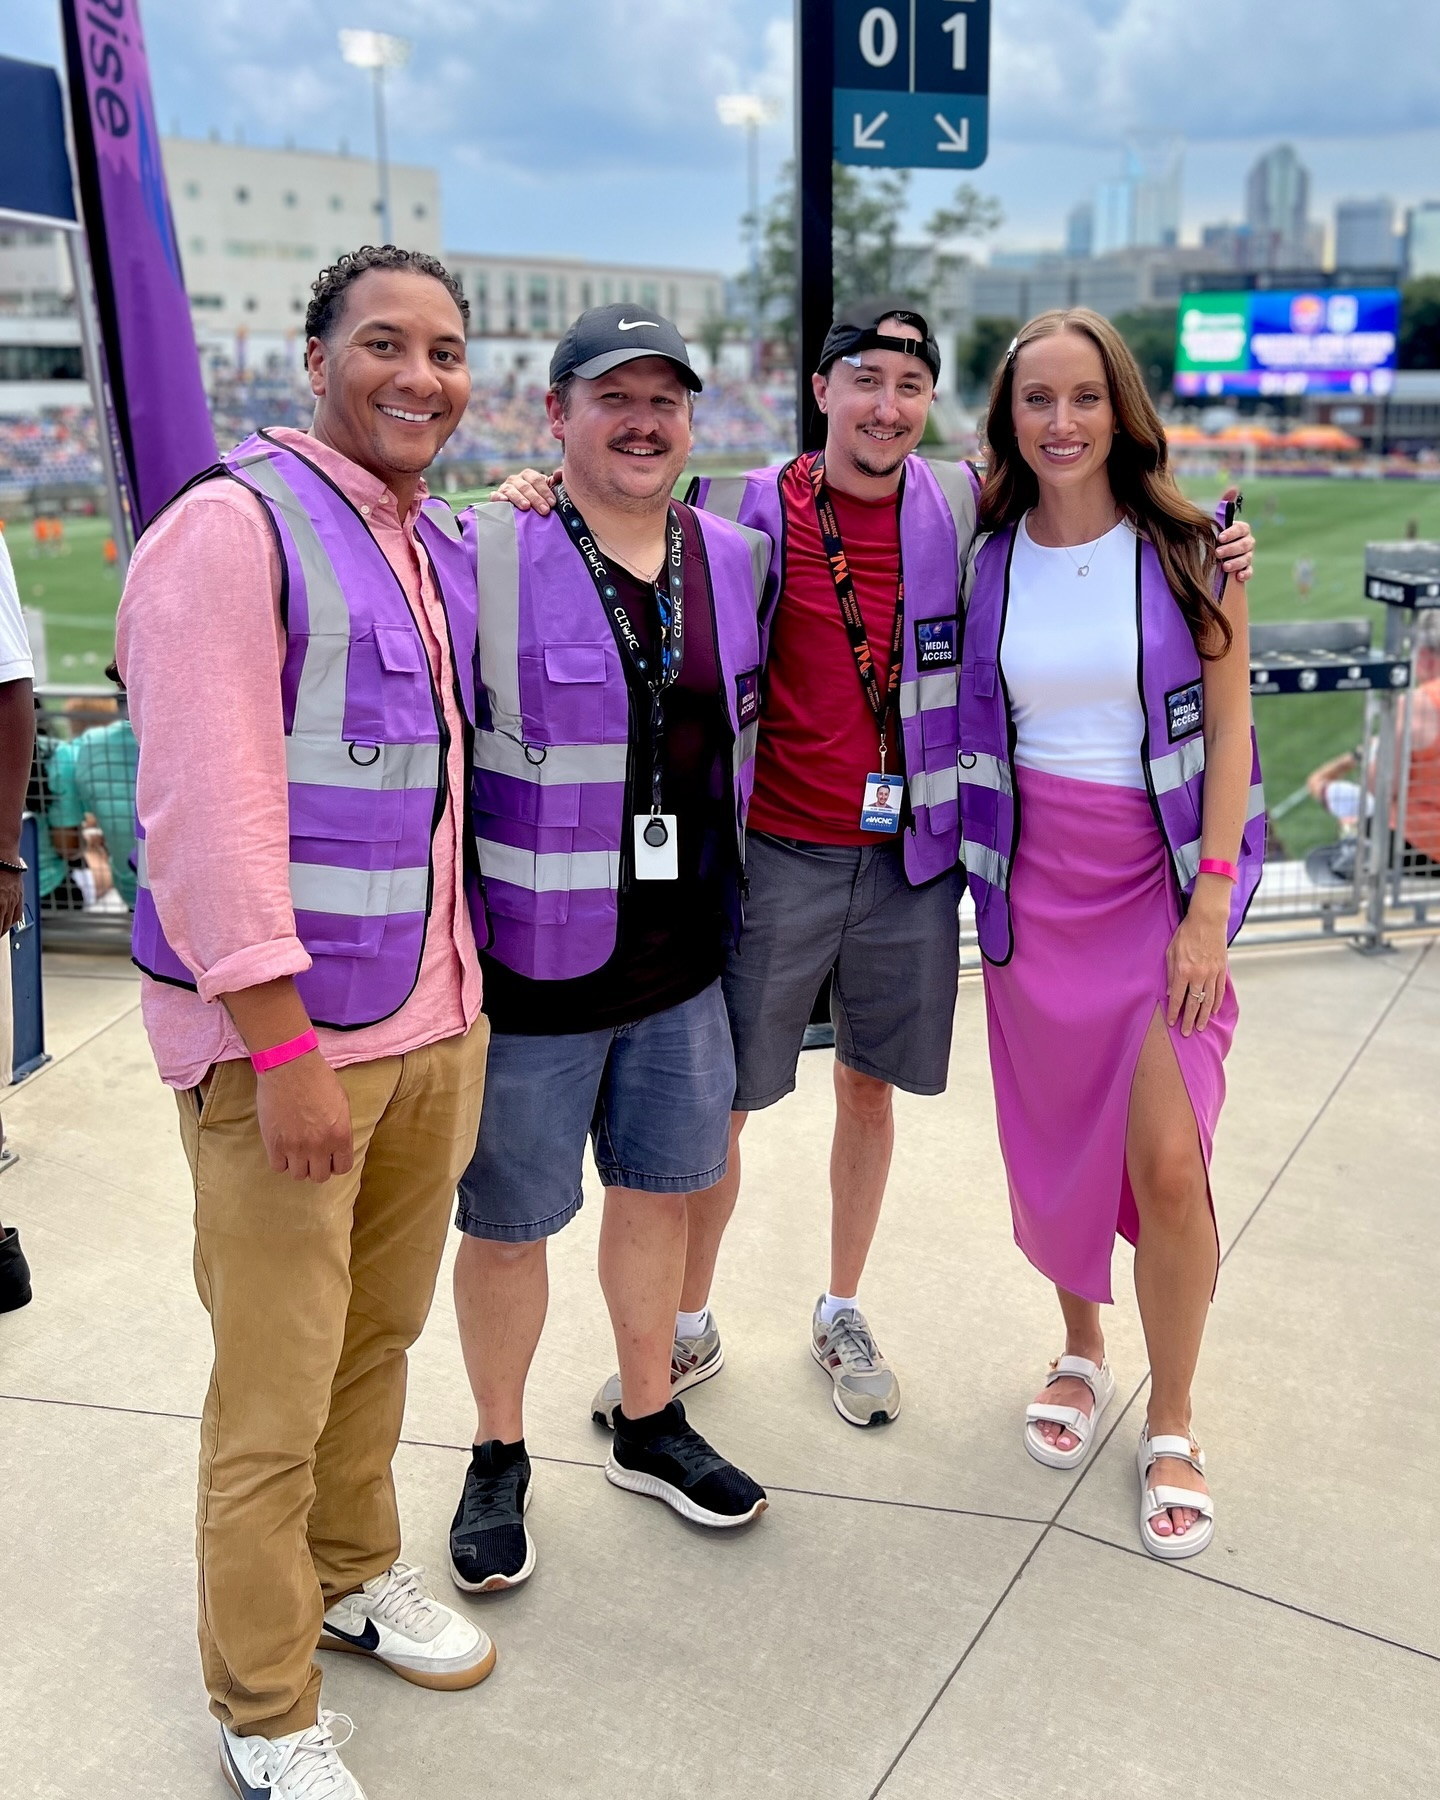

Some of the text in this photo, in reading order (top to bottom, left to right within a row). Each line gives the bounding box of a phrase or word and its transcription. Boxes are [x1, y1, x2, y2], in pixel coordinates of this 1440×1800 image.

[859, 6, 898, 67] 0
[941, 12, 967, 70] 1
[925, 641, 949, 651] MEDIA
[922, 651, 952, 661] ACCESS
[1173, 702, 1196, 717] MEDIA
[1171, 712, 1199, 728] ACCESS
